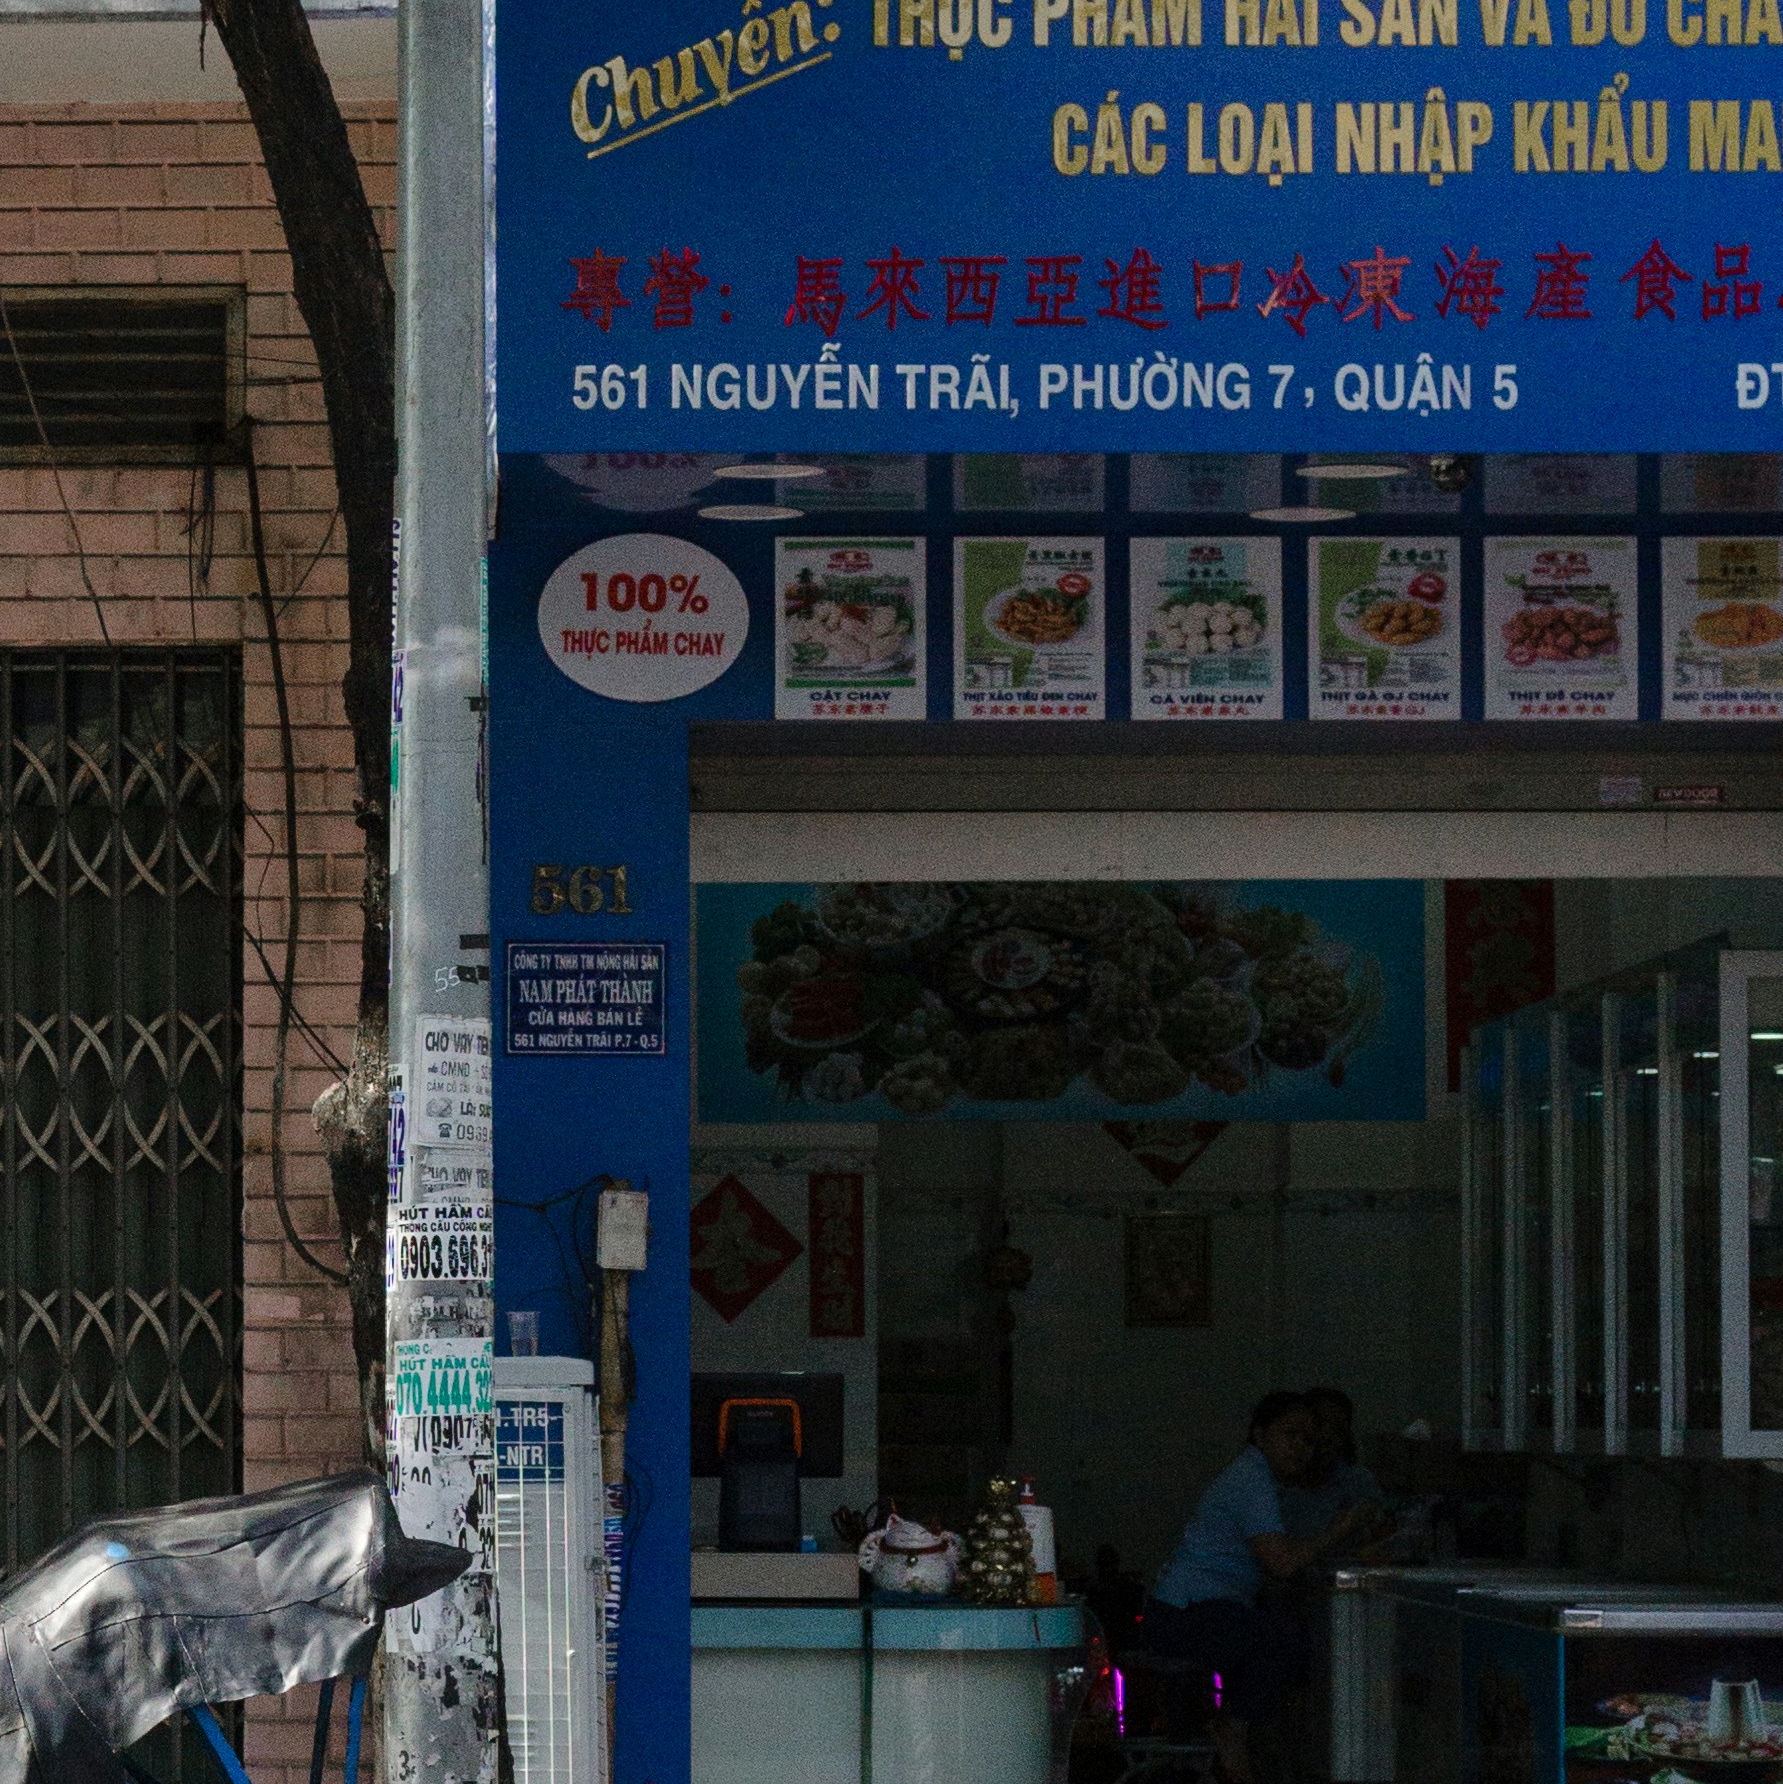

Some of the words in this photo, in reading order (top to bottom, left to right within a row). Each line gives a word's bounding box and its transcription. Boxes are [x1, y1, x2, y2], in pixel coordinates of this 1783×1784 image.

[1052, 90, 1166, 176] CÁC
[1188, 103, 1313, 186] LOẠI
[1335, 87, 1494, 186] NHẬP
[1515, 72, 1668, 174] KHẨU
[1688, 100, 1783, 173] MA
[572, 364, 647, 410] 561
[672, 343, 879, 410] NGUYỄN
[896, 354, 1019, 418] TRÃI,
[1040, 352, 1250, 410] PHƯỜNG
[1335, 353, 1472, 416] QUẬN
[1493, 364, 1519, 409] 5
[580, 572, 709, 614] 100%
[561, 628, 610, 661] THỰC
[616, 618, 668, 655] PHẨM
[674, 632, 724, 656] CHAY
[809, 690, 842, 702] CẬT
[847, 691, 891, 701] CHAY
[963, 691, 985, 702] THỊT
[1067, 692, 1097, 701] CHAY
[1150, 694, 1174, 704] CÁ
[1180, 692, 1215, 704] VIÊN
[1220, 694, 1264, 704] CHAY
[1321, 691, 1348, 703] THỊT
[1407, 692, 1450, 702] CHAY
[1509, 691, 1541, 702] THỊT
[1570, 691, 1615, 701] CHAY
[532, 864, 633, 915] 561
[514, 949, 538, 970] CÔNG
[540, 954, 551, 970] TY
[520, 980, 553, 1003] NAM
[556, 973, 597, 1003] PHÁT
[600, 973, 653, 1003] THÀNH
[596, 1007, 623, 1026] BÁN
[425, 1031, 449, 1052] CHO
[514, 1033, 534, 1047] 561
[538, 1028, 582, 1048] NGUYỄN
[614, 1034, 632, 1048] P.7
[640, 1034, 658, 1049] Q.5
[399, 1204, 429, 1220] HÚT
[400, 1357, 426, 1372] HÚT
